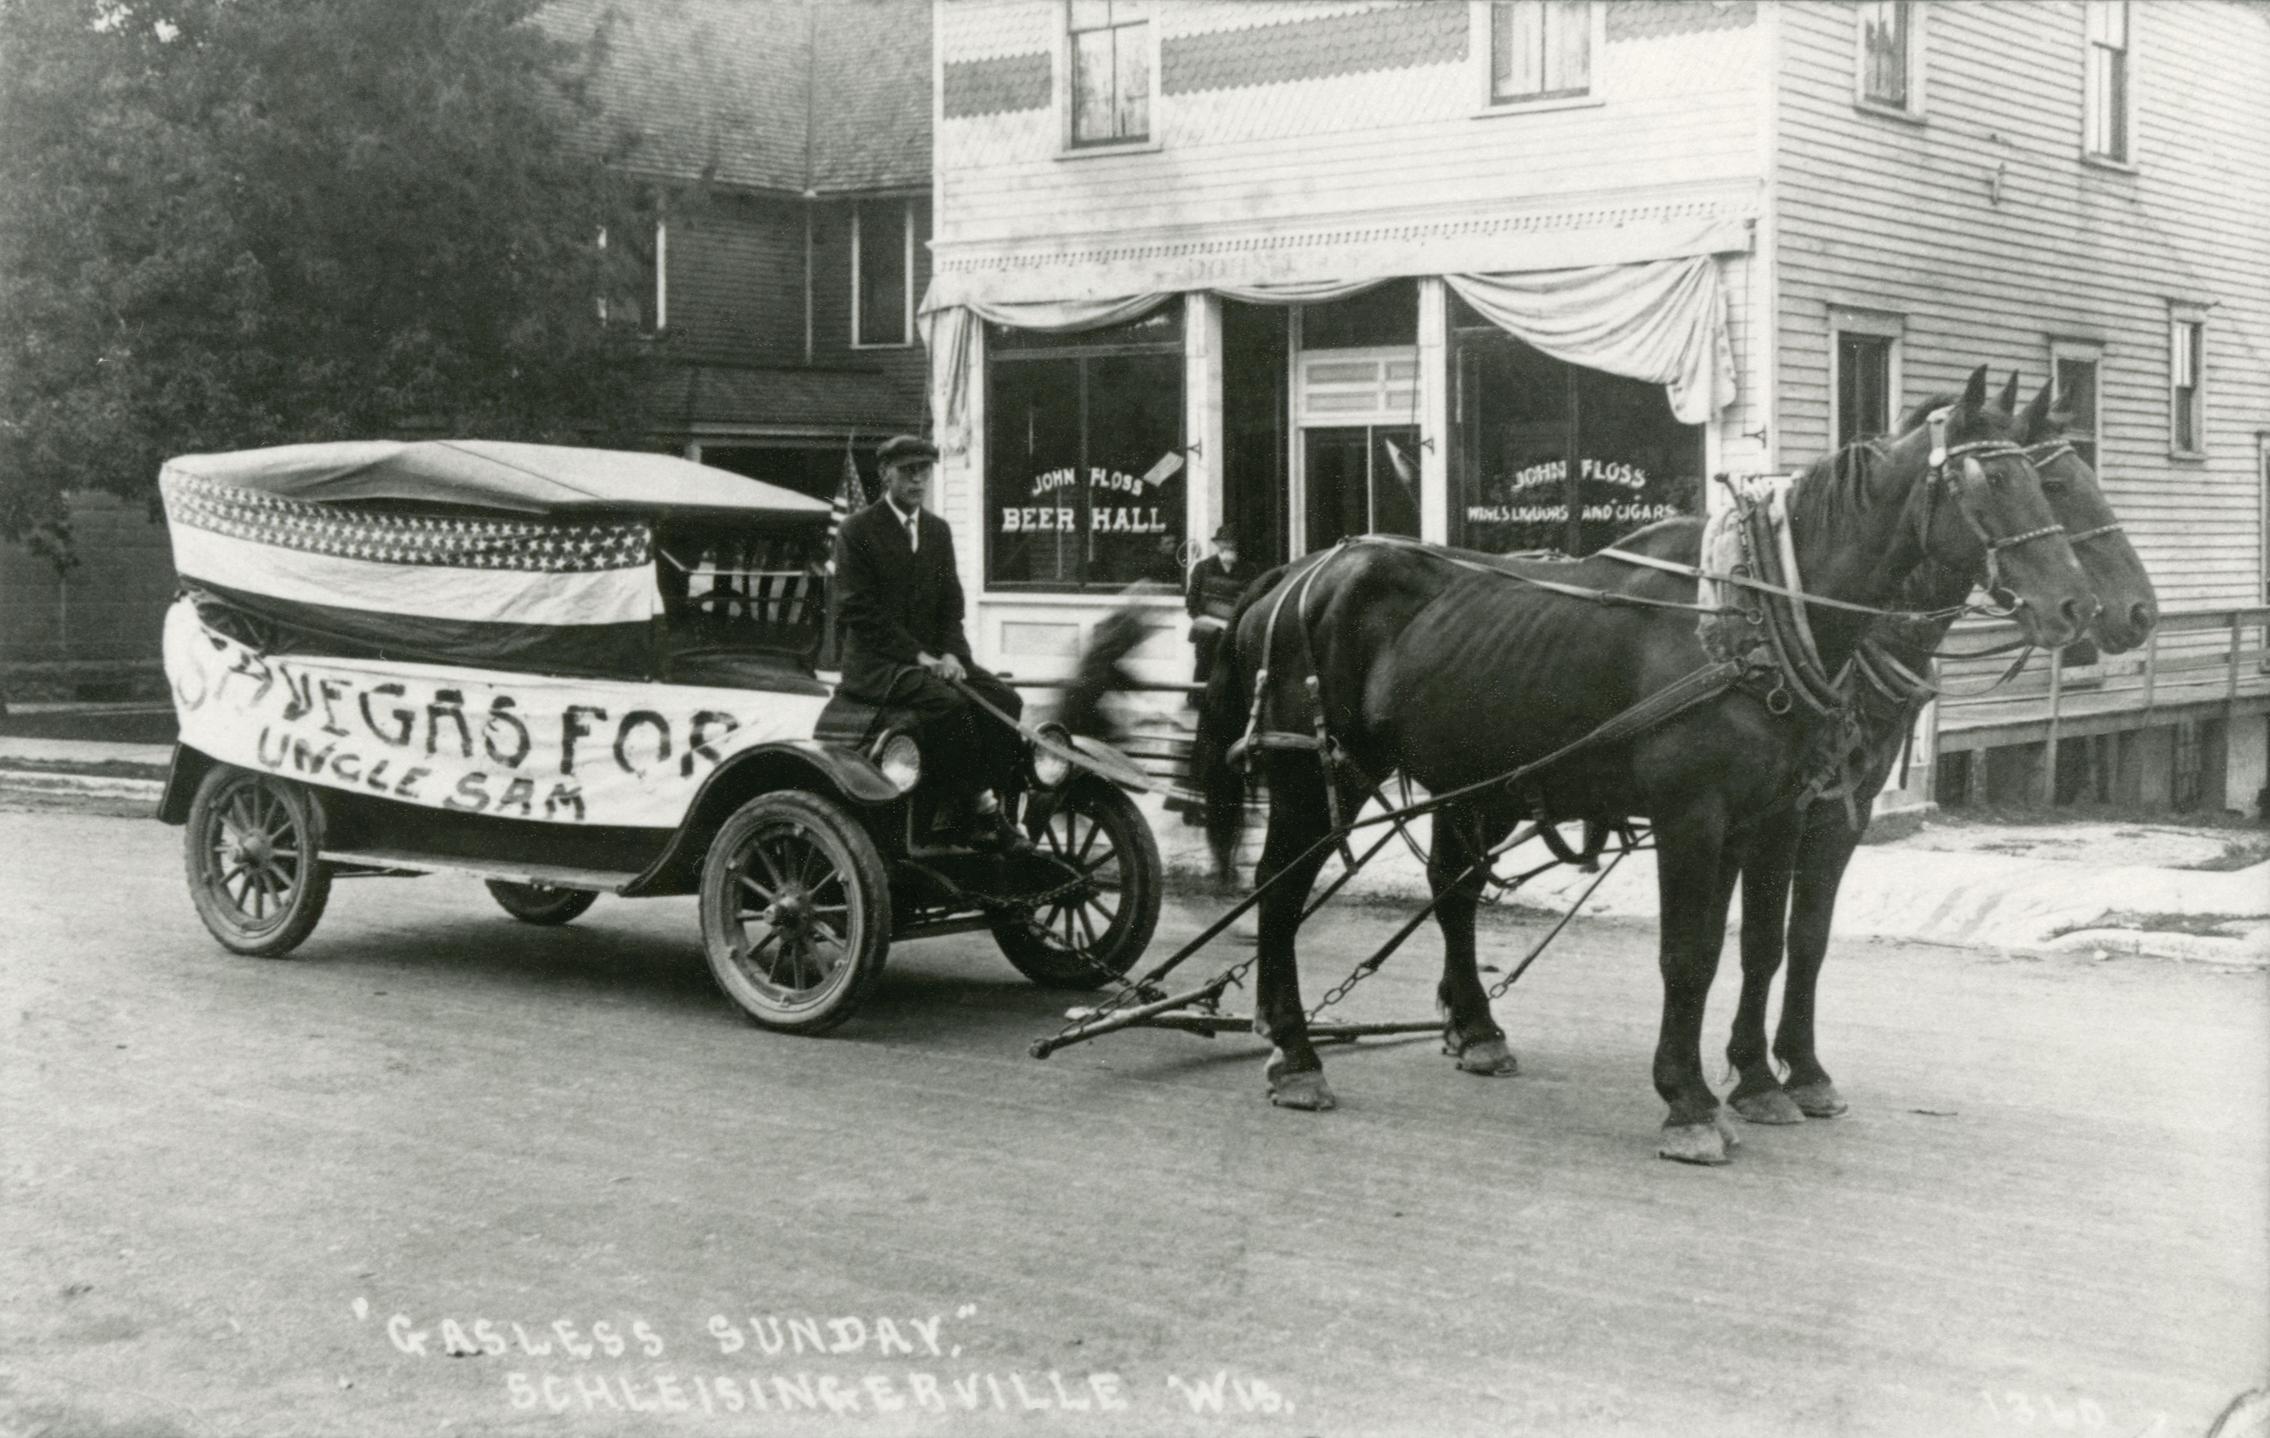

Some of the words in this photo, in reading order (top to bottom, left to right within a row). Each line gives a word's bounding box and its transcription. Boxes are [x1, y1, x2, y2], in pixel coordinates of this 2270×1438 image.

[1032, 468, 1075, 496] JOHN
[1090, 467, 1143, 496] FLOSS
[1511, 460, 1567, 492] JOHN
[1580, 459, 1646, 488] FLOSS
[1002, 507, 1075, 532] BEER
[1091, 507, 1166, 532] HALL
[1581, 504, 1612, 520] AND
[1616, 503, 1677, 520] CIGARS
[359, 683, 531, 769] GAS
[561, 704, 740, 778] FOR
[257, 726, 432, 798] UNCLE
[444, 772, 586, 821] SAM
